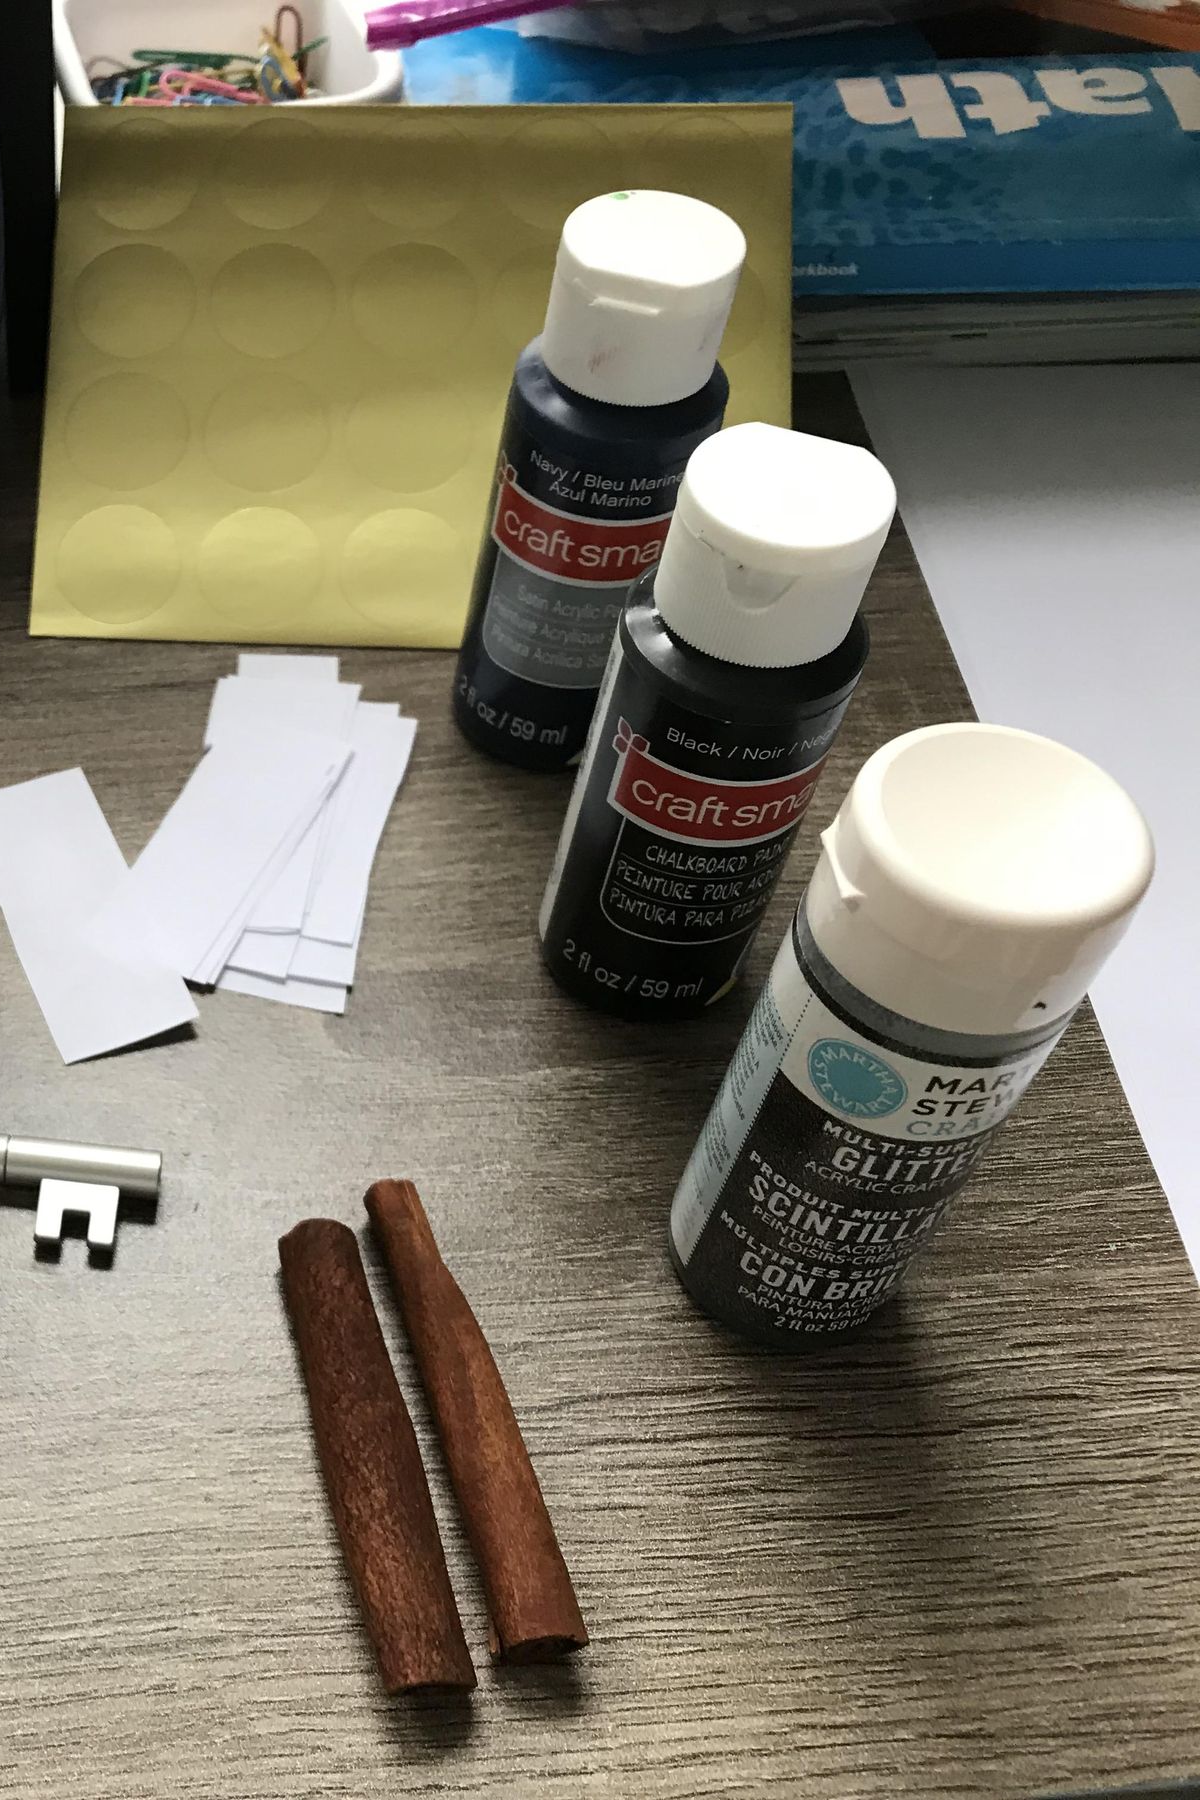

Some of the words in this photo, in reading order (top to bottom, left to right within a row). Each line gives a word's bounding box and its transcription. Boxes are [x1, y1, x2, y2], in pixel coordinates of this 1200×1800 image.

[530, 450, 568, 482] Navy
[584, 474, 624, 491] Bleu
[549, 481, 585, 503] Azul
[590, 491, 652, 507] Marino
[578, 539, 661, 568] sma
[477, 701, 497, 726] oz
[510, 716, 535, 740] 59
[540, 725, 567, 744] ml
[667, 727, 722, 757] Black
[742, 746, 785, 760] Noir
[732, 781, 815, 828] sma
[646, 845, 748, 873] CHALKBOARD
[616, 860, 697, 899] PEINTURE
[702, 882, 742, 901] POUR
[609, 887, 676, 925] PINTURA
[684, 912, 724, 927] PARA
[563, 938, 576, 961] 2
[578, 952, 591, 973] fl
[594, 967, 622, 989] oz
[640, 979, 669, 998] 59
[674, 976, 704, 998] ml
[813, 1058, 890, 1114] STEWART
[820, 1046, 899, 1094] MARTHA
[906, 1114, 992, 1137] CRA
[750, 1150, 844, 1214] PRODUIT
[804, 1161, 888, 1193] ACRYLIC
[749, 1174, 941, 1243] SCINTILLA
[753, 1205, 836, 1250] PEINTURE
[740, 1251, 816, 1297] CON
[823, 1269, 900, 1299] BRIL
[738, 1285, 780, 1312] PARA
[757, 1284, 833, 1310] PINTURA
[774, 1316, 786, 1328] 2
[805, 1323, 824, 1332] oz
[827, 1319, 849, 1331] 59
